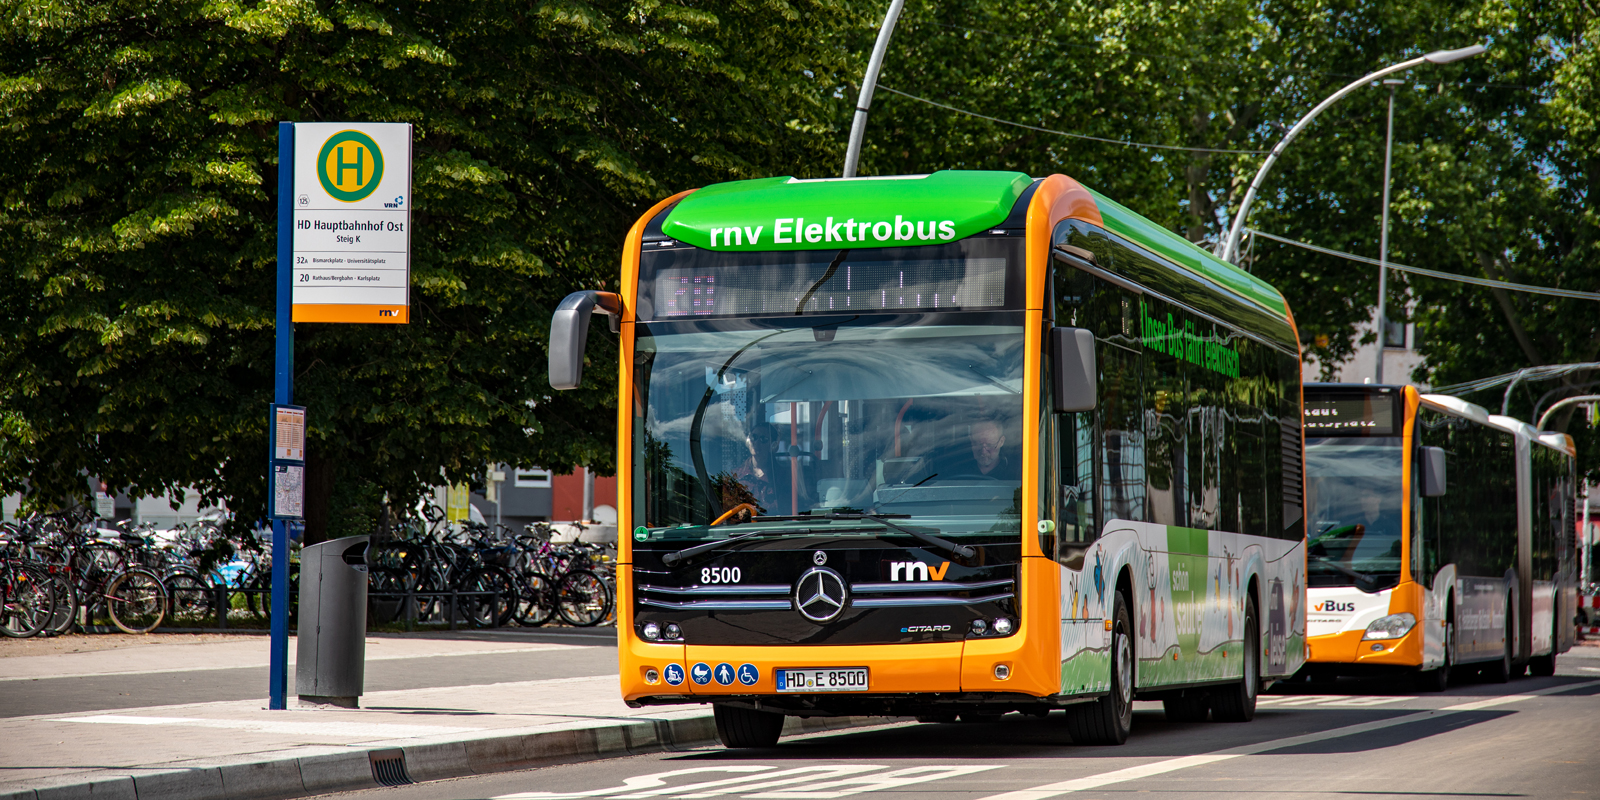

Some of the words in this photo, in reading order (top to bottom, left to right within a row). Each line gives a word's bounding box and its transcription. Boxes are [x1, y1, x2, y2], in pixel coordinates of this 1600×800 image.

[337, 147, 363, 186] H
[297, 220, 311, 230] HD
[314, 220, 384, 233] Hauptbahnhof
[386, 221, 404, 232] Ost
[710, 225, 763, 247] rnv
[774, 215, 956, 244] Elektrobus
[336, 235, 354, 244] Steig
[300, 273, 310, 282] 20
[379, 309, 399, 317] rnv
[1140, 300, 1167, 354] Unser
[1167, 312, 1184, 361] Bus
[1184, 318, 1205, 368] fährt
[1205, 329, 1240, 379] elektrisch
[700, 566, 742, 584] 8500
[890, 561, 951, 582] rnv
[1172, 562, 1190, 592] schön
[1176, 590, 1206, 636] sauber
[1314, 600, 1355, 612] vBus
[900, 625, 951, 633] eCITARO
[786, 672, 805, 688] HD
[815, 672, 825, 686] E
[828, 671, 866, 686] 8500
